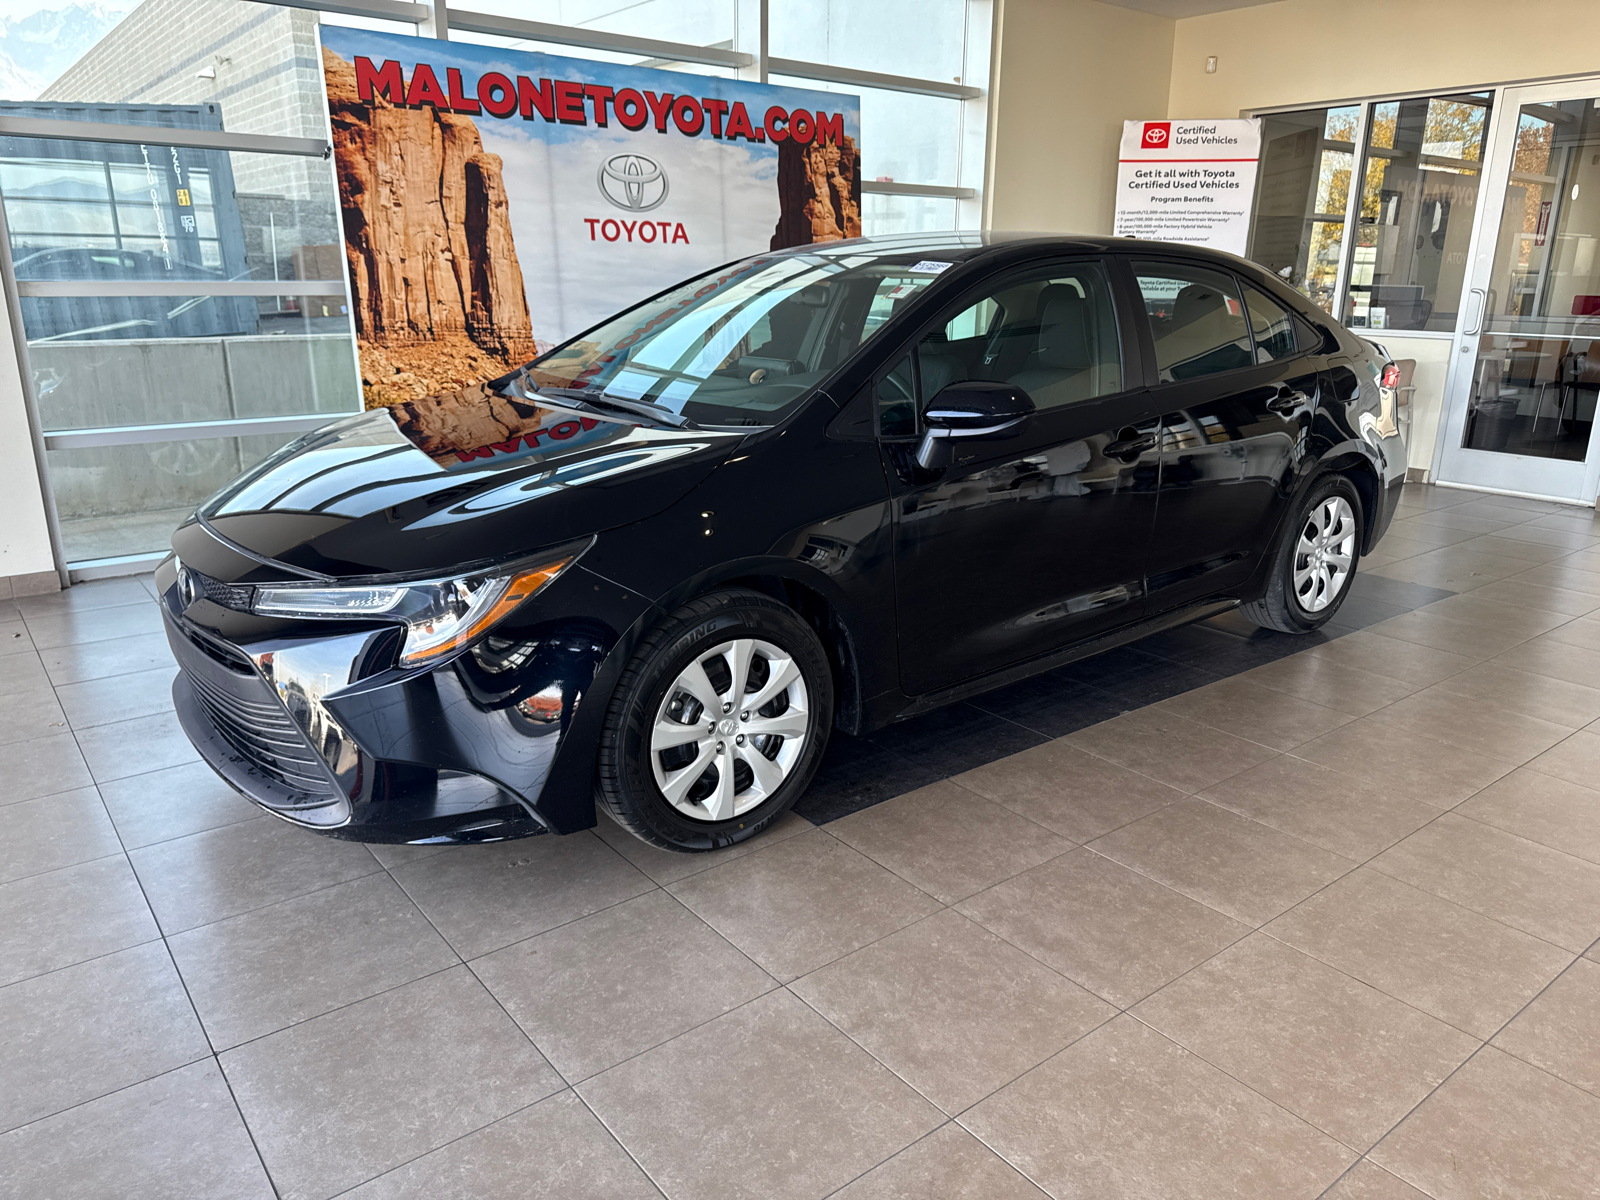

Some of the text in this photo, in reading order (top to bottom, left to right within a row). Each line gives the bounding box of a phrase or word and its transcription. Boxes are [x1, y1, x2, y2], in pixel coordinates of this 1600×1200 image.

[354, 55, 845, 147] MALONETOYOTA.COM
[1177, 126, 1216, 135] Certified
[1176, 136, 1238, 145] Used Vehicles
[1135, 170, 1235, 179] Get it all with Toyota
[1129, 181, 1240, 189] Certified Used Vehicles
[584, 218, 690, 245] TOYOTA
[651, 619, 717, 680] TOURING
